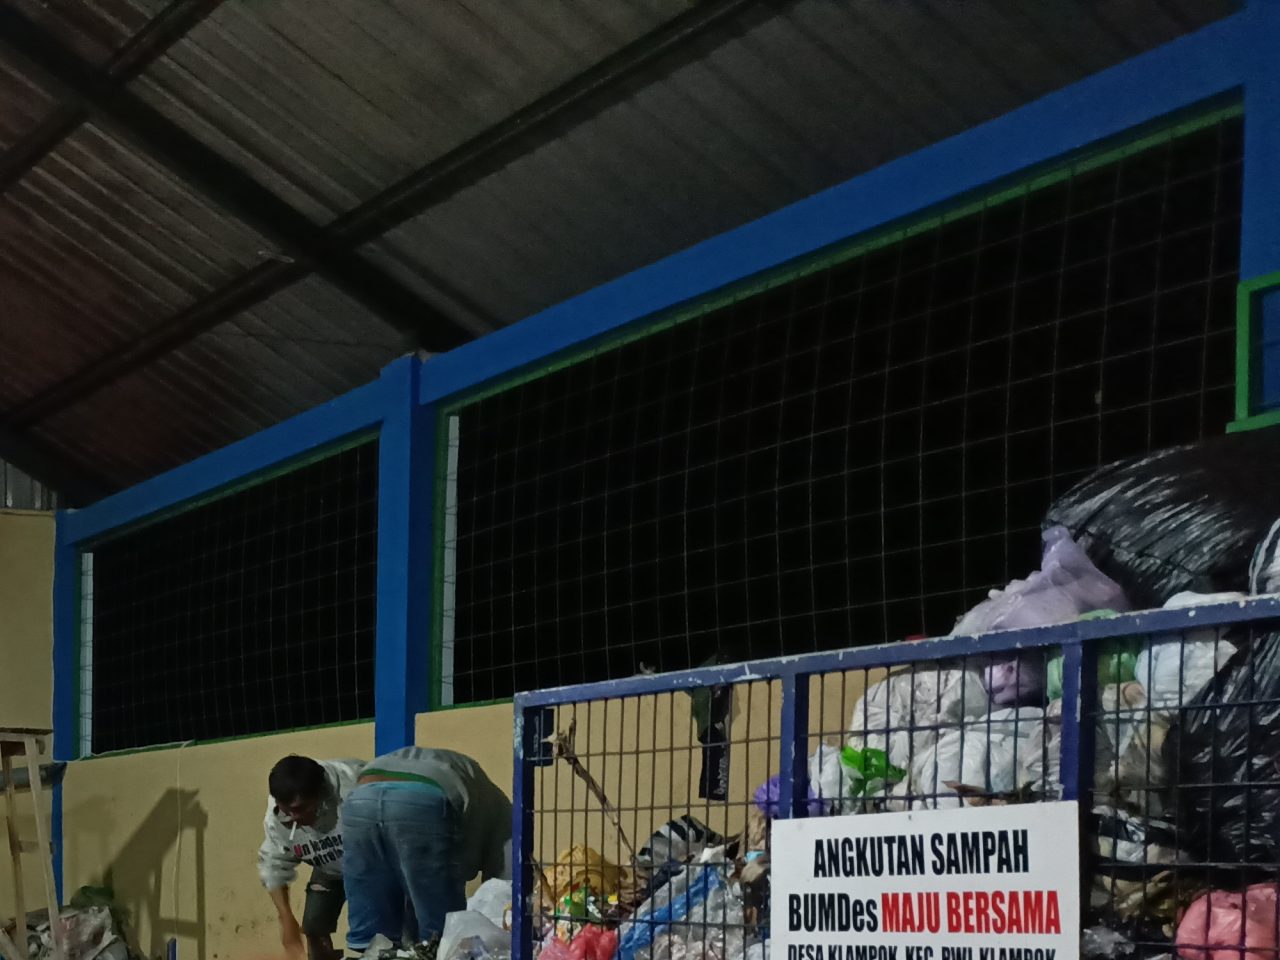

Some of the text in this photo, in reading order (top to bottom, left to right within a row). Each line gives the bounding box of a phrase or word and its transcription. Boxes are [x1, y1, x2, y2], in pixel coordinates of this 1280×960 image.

[813, 829, 1030, 878] ANGKUTAN SAMPAH
[787, 890, 1061, 934] BUMDes MAJU BERSAMA
